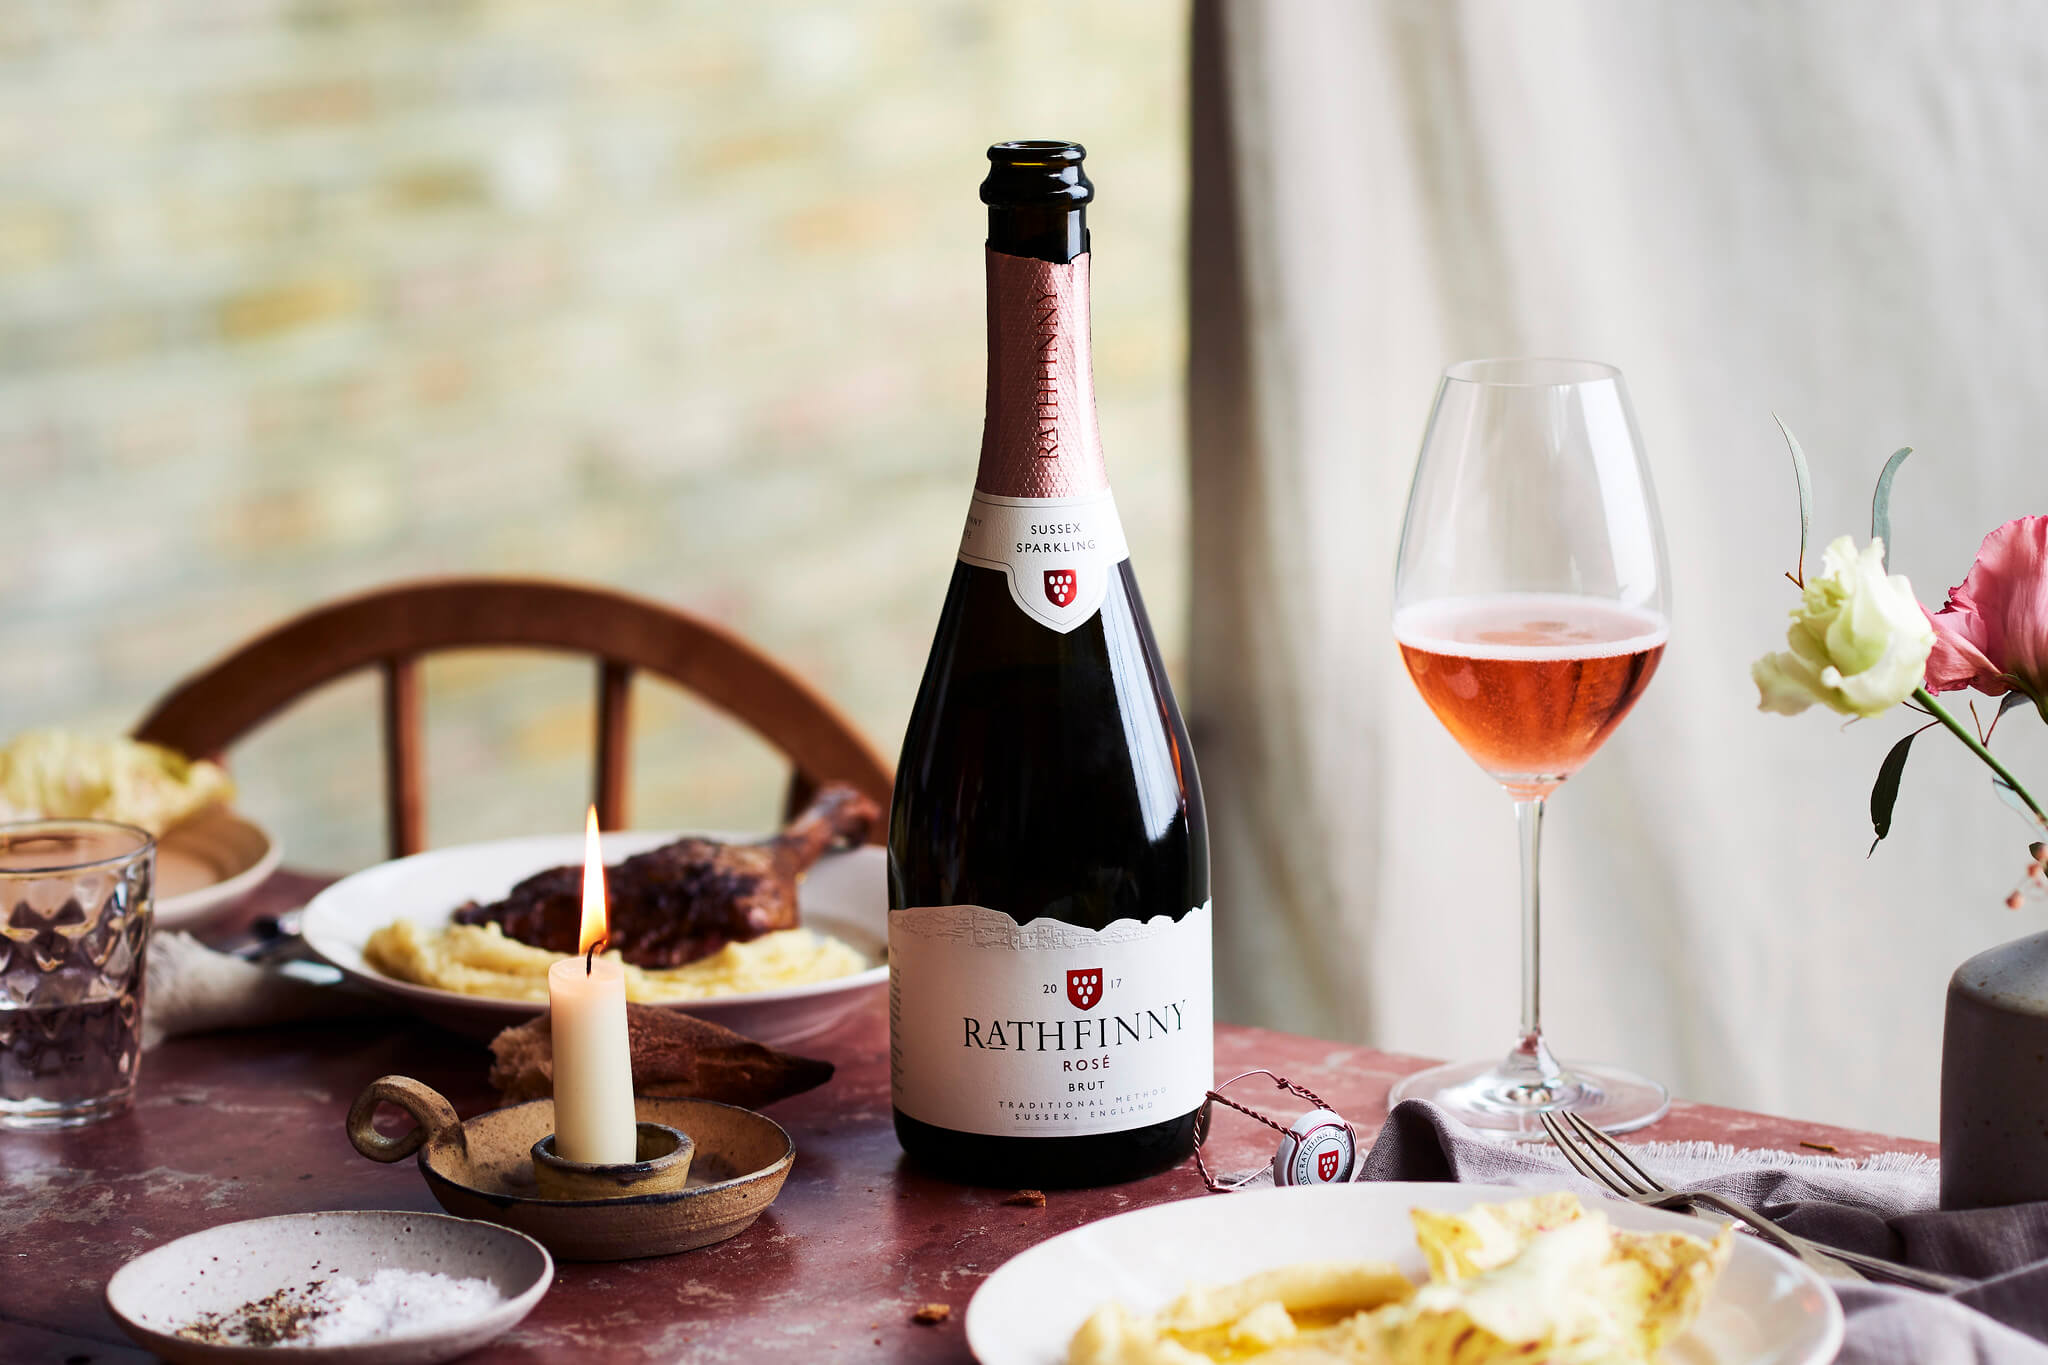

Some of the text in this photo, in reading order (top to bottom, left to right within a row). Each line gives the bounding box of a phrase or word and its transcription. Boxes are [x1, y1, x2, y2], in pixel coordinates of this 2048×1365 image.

[1037, 287, 1059, 460] RATHFINNY
[1030, 522, 1082, 535] SUSSEX
[1016, 539, 1096, 553] SPARKLING
[1042, 978, 1122, 994] 20 17
[963, 999, 1187, 1052] RATHFINNY
[1063, 1054, 1110, 1072] ROSÉ
[1068, 1080, 1105, 1093] BRUT
[999, 1087, 1167, 1110] TRADITIONAL METHOD
[1090, 1102, 1153, 1119] ENGLAND
